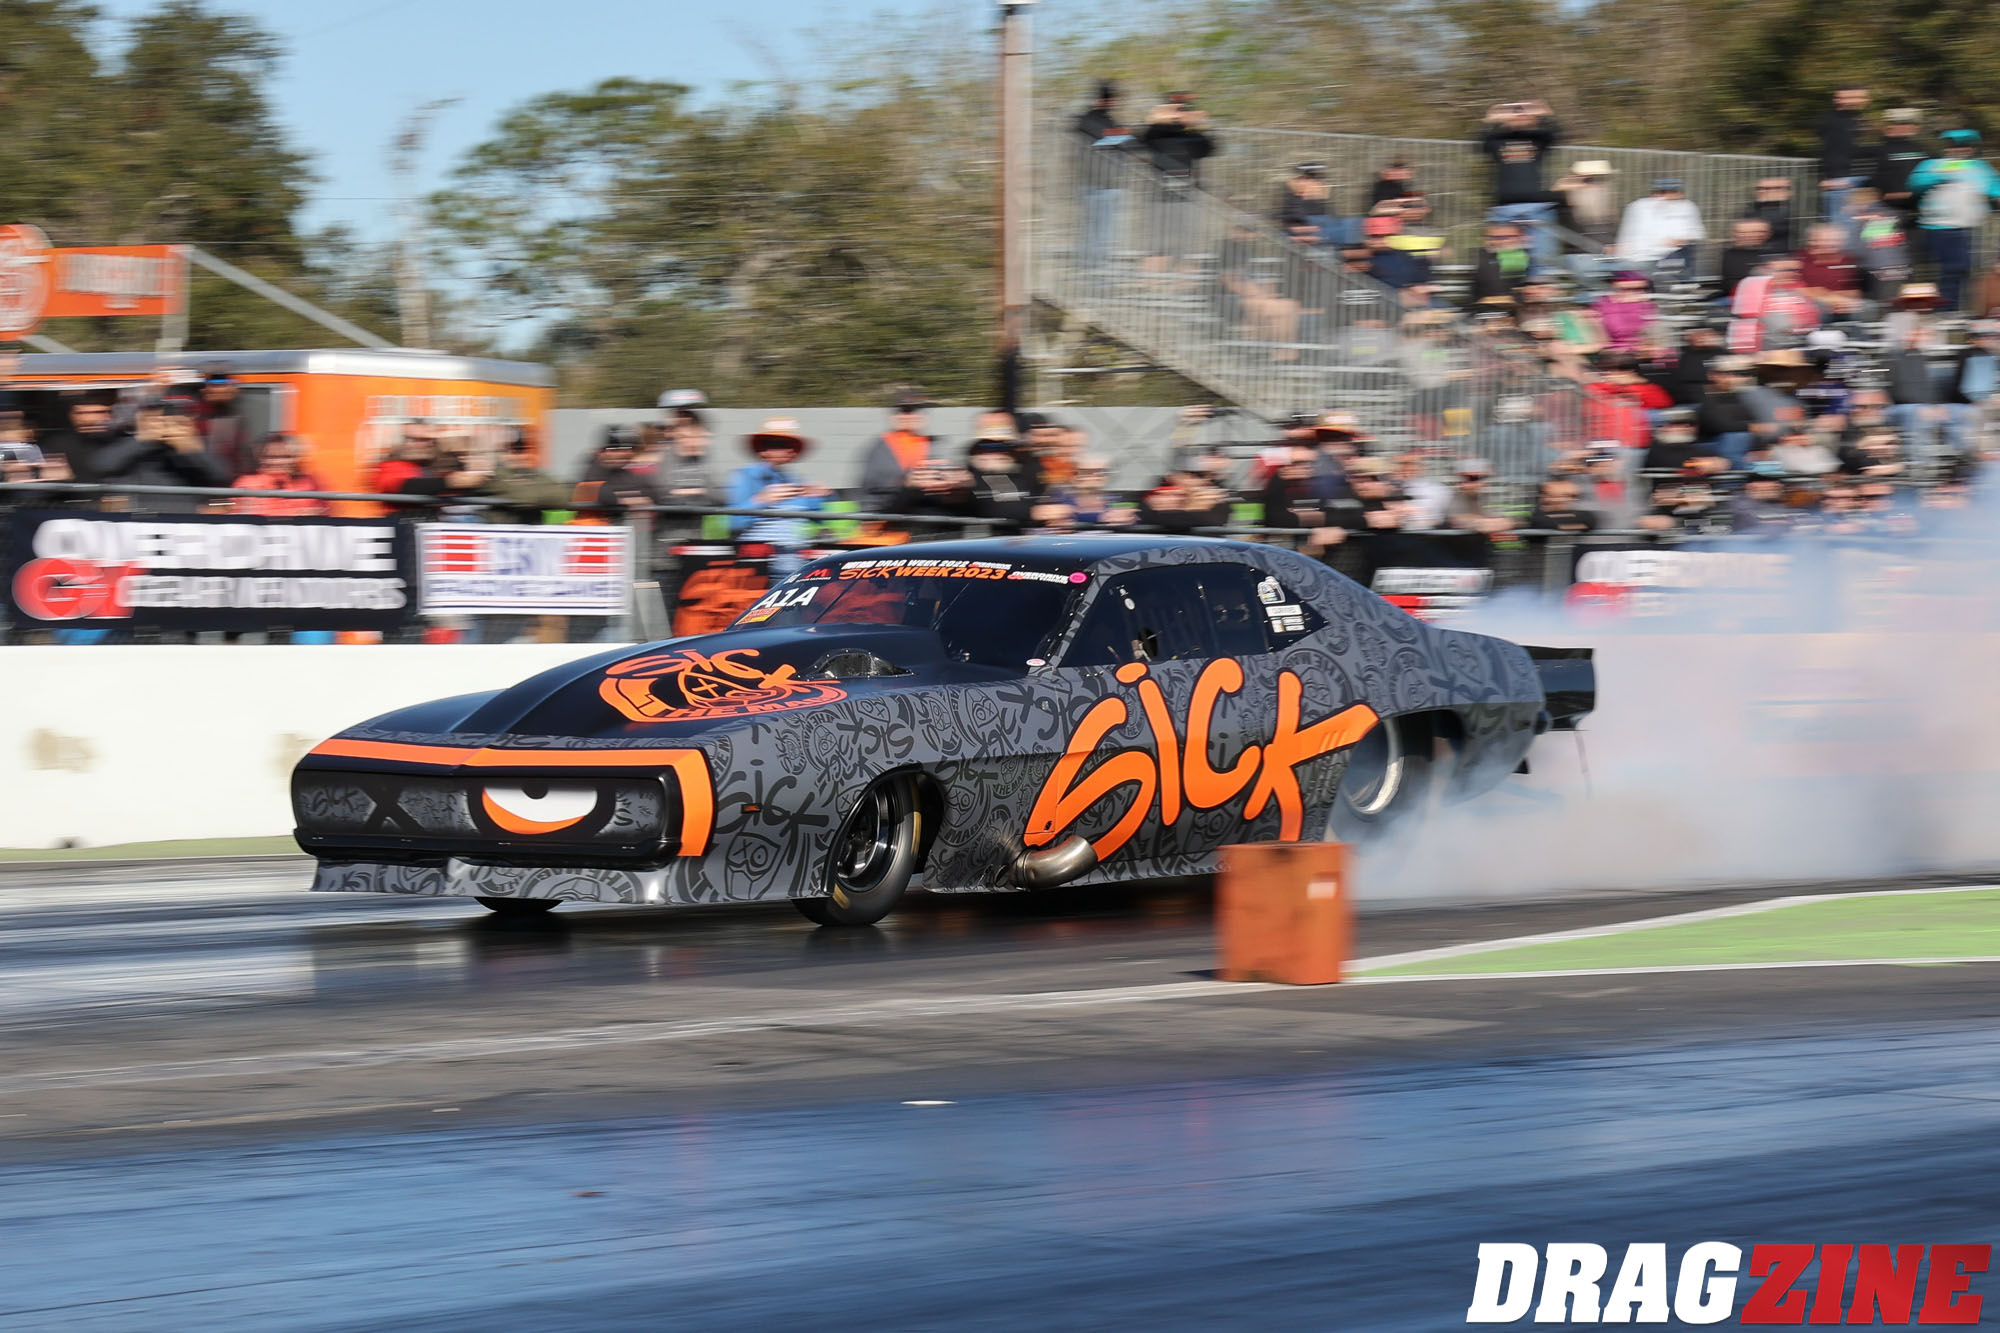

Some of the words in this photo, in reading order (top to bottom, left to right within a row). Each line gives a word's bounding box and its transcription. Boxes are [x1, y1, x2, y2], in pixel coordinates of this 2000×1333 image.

[838, 566, 897, 579] SICK
[895, 566, 955, 578] WEEK
[951, 567, 1007, 580] 2023
[907, 559, 941, 568] WEEK
[751, 586, 819, 610] A1A
[1024, 657, 1379, 862] SICK
